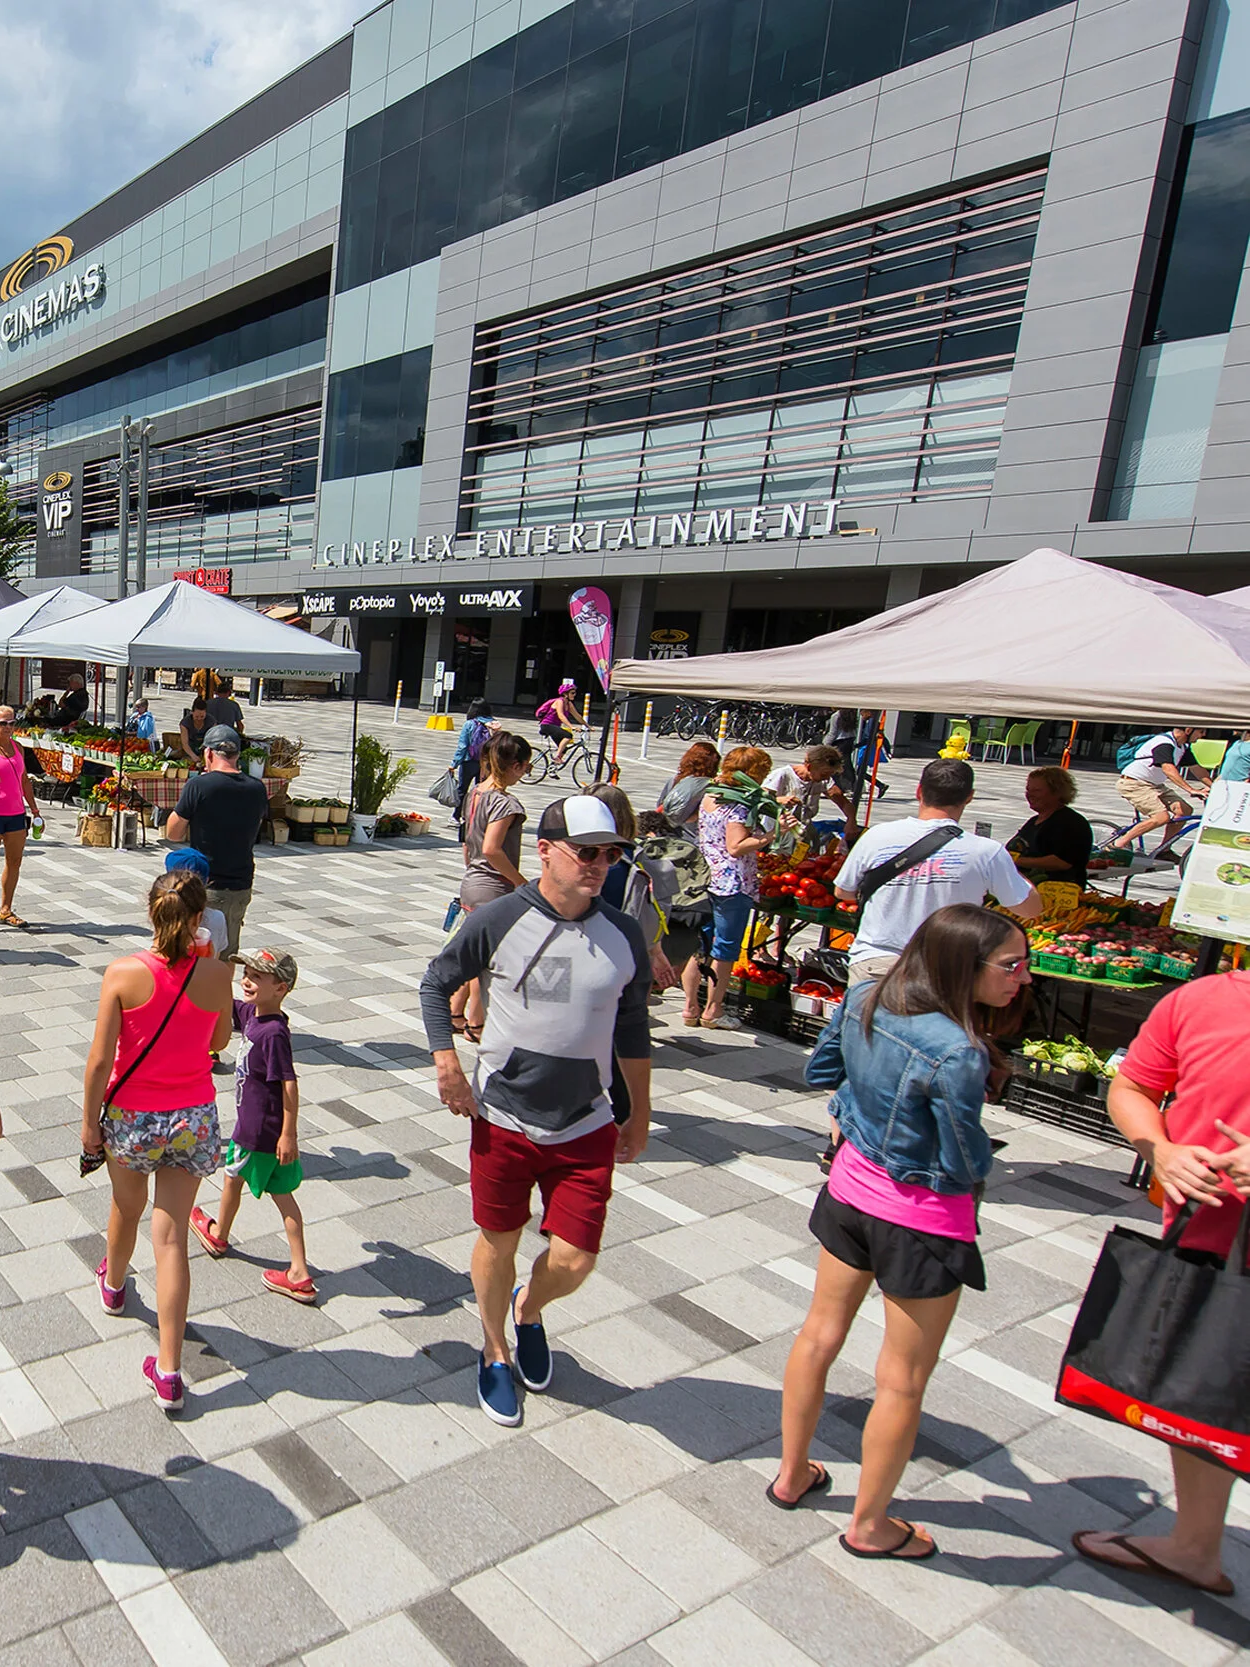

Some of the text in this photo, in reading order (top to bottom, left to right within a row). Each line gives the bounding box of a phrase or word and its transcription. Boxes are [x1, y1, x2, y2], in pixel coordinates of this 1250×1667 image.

[0, 263, 104, 343] CINEMAS
[42, 491, 71, 504] CINEPLEX
[42, 501, 72, 530] VIP
[324, 500, 844, 564] CINEPLEX ENTERTAINMENT
[205, 568, 230, 586] CRATE
[1232, 791, 1250, 824] Ottawa
[1141, 1412, 1242, 1460] SOURCE
